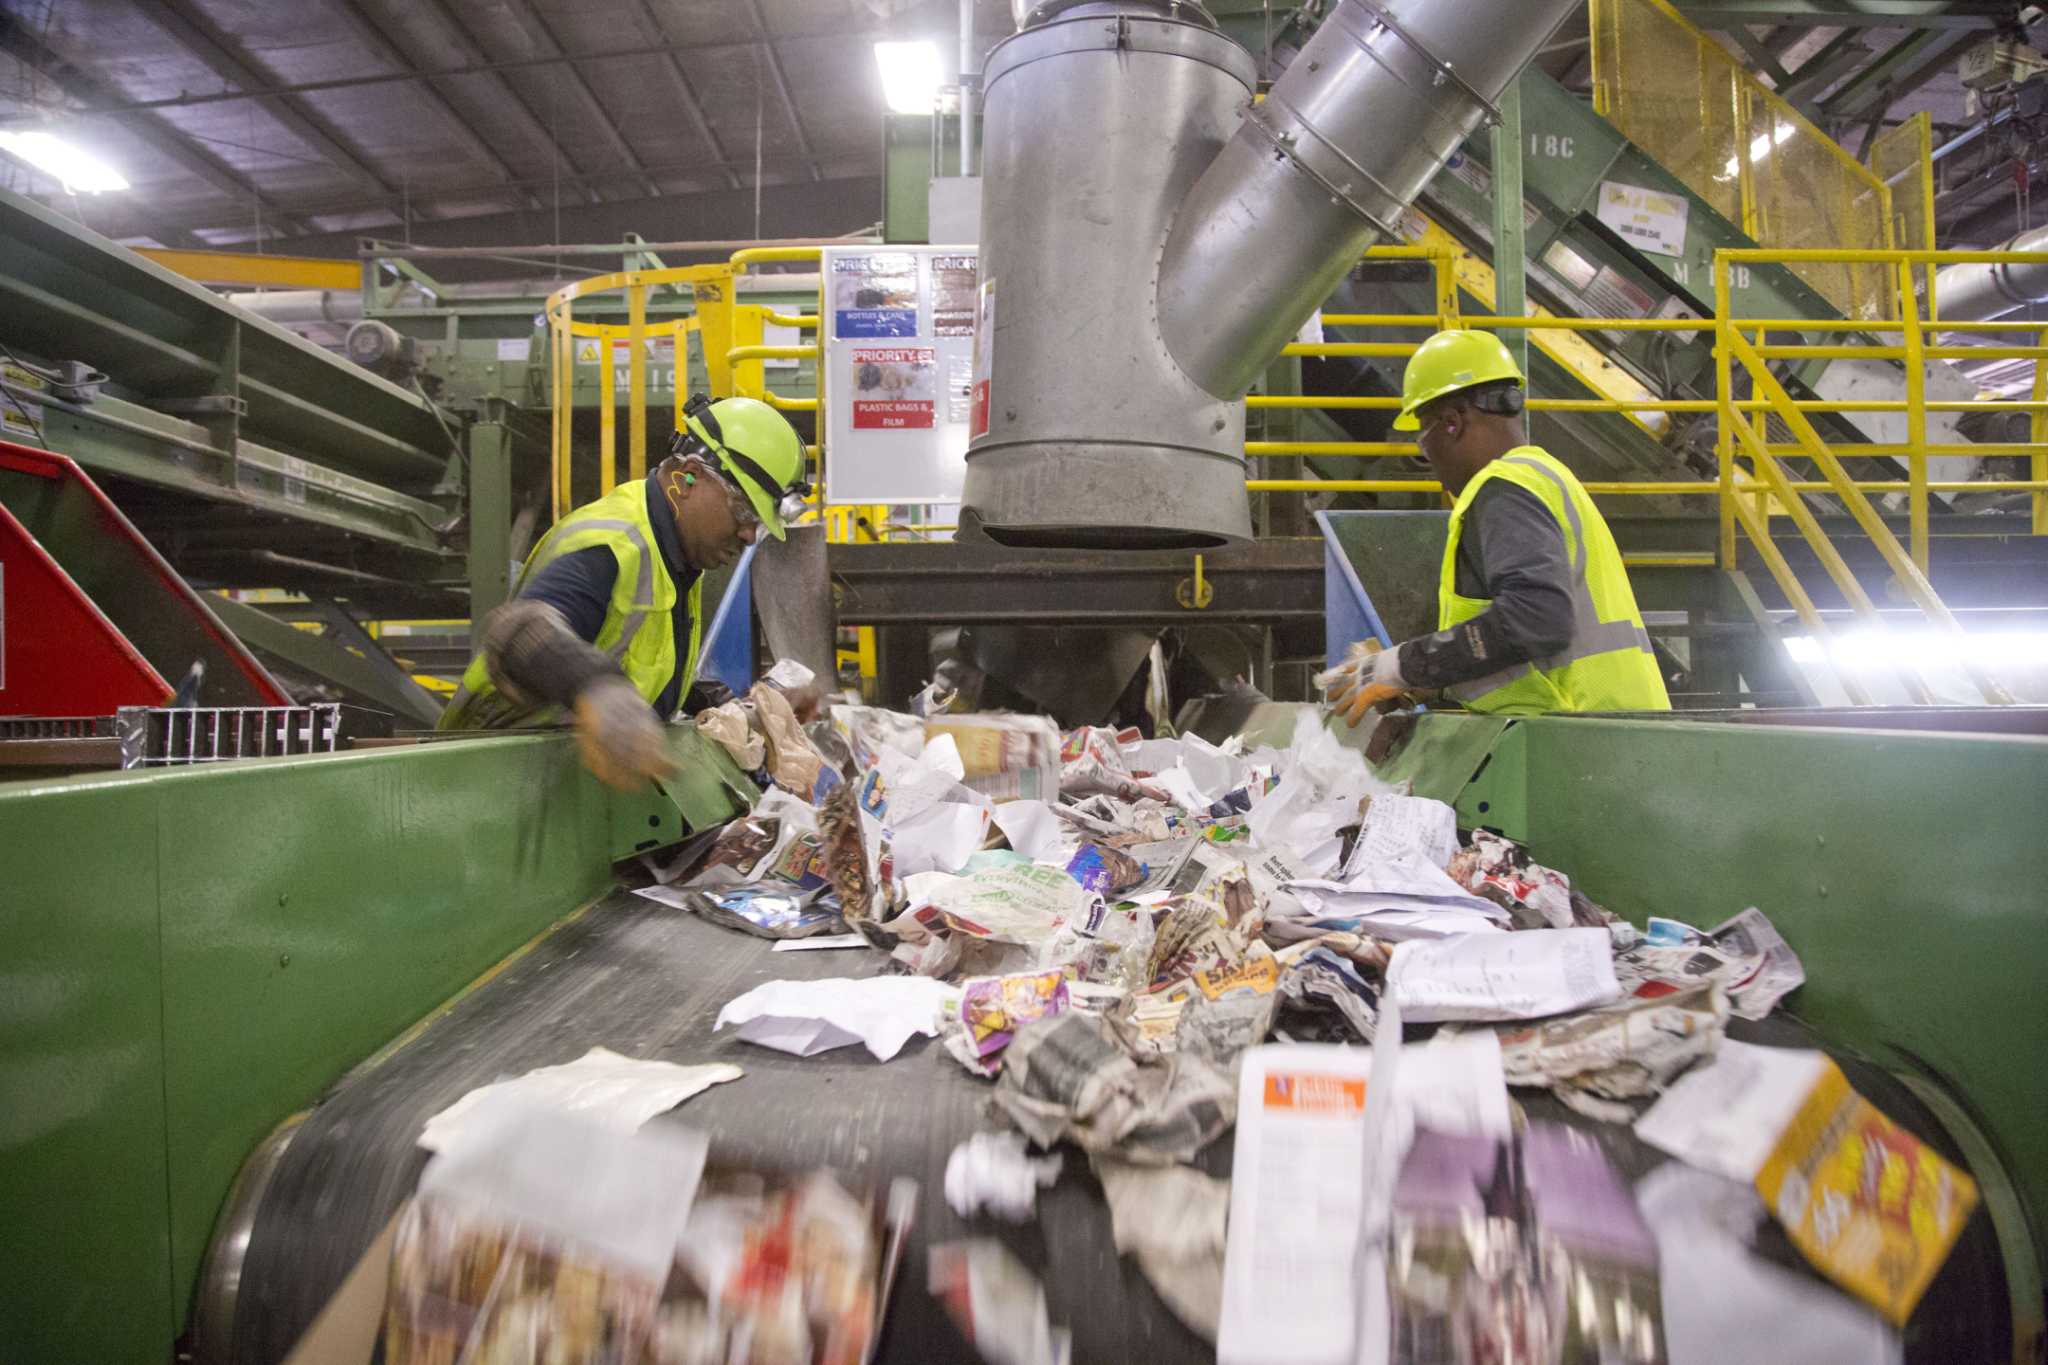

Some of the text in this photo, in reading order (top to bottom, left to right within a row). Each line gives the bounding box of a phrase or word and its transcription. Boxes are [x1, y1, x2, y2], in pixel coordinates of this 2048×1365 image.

[1531, 134, 1574, 158] 18C
[935, 258, 976, 270] PRIOR
[854, 350, 914, 361] PRIORITY
[860, 403, 894, 412] PLASTIC
[896, 403, 918, 412] BAGS
[883, 418, 905, 427] FILM
